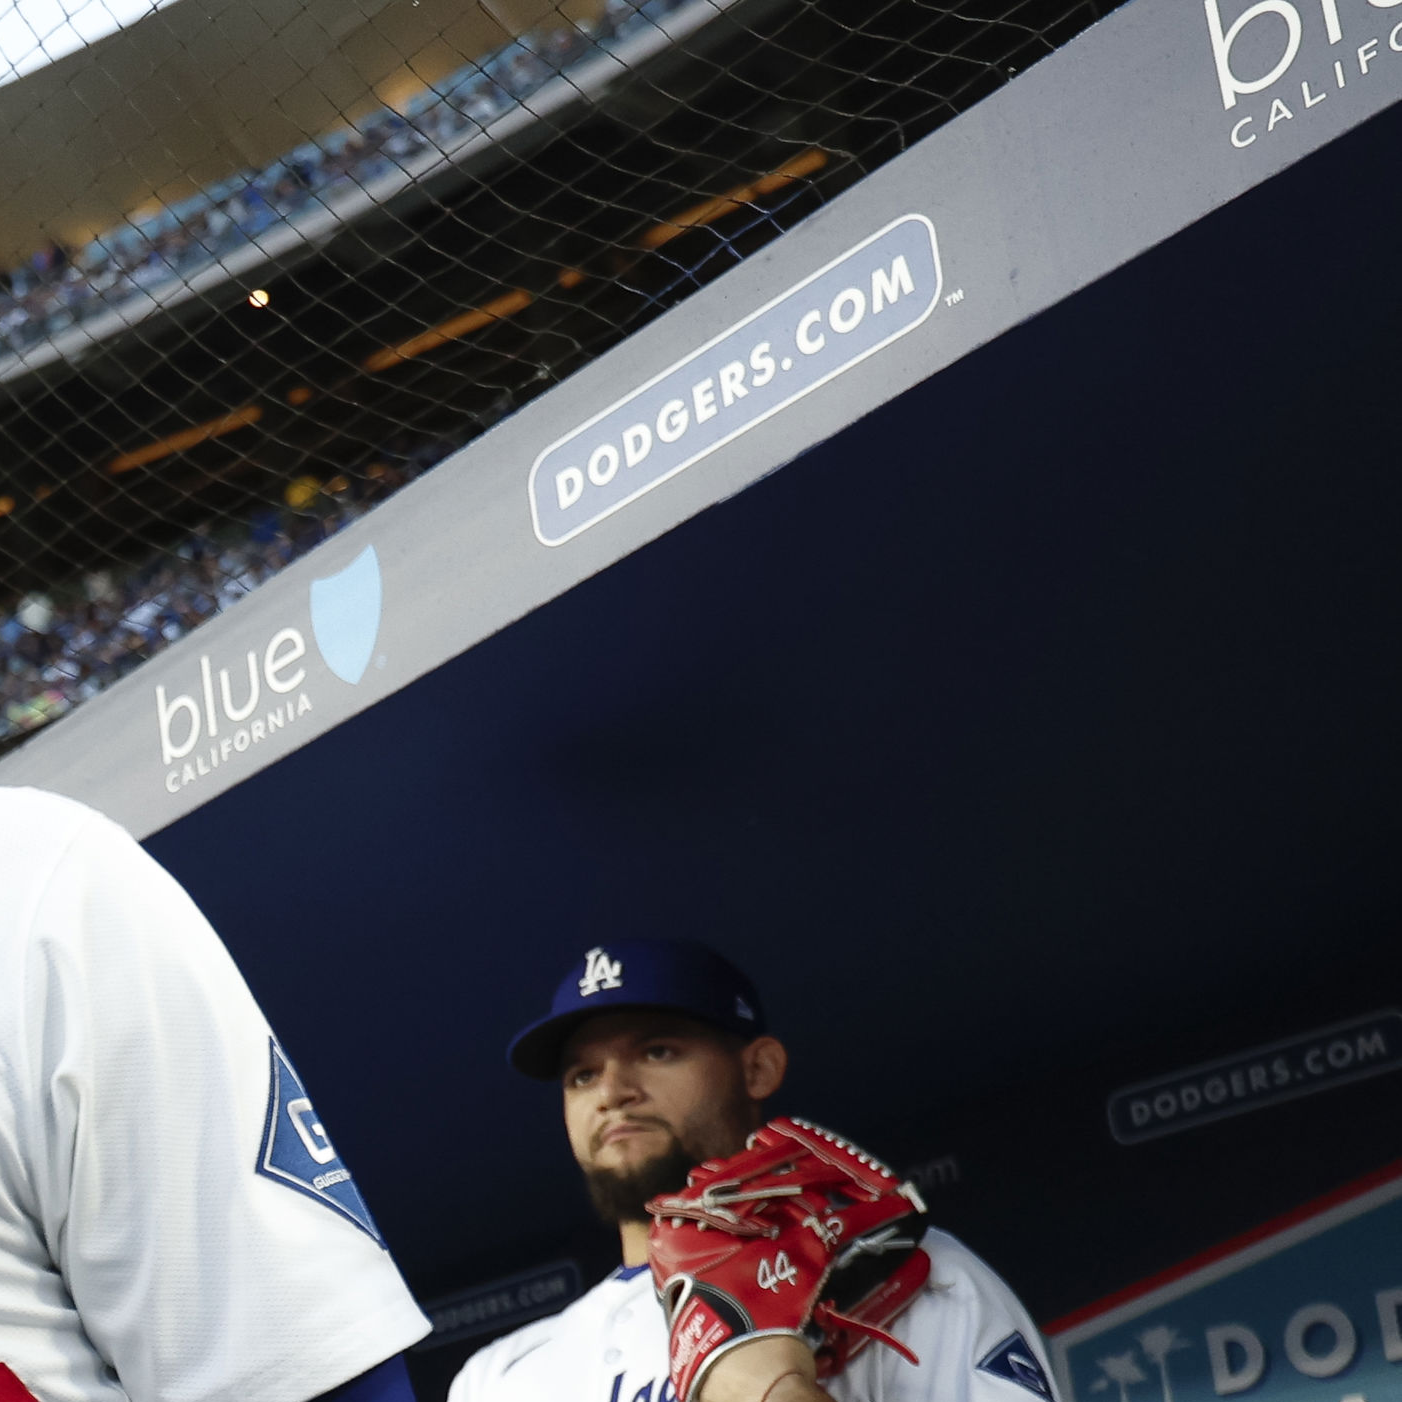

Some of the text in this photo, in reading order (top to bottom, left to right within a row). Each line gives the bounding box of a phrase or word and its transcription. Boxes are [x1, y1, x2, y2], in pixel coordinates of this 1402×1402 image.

[555, 254, 916, 510] DODGERS.COM
[156, 627, 306, 765] blue
[165, 692, 313, 794] CALIFORNIA
[579, 946, 623, 997] LA
[1130, 1030, 1387, 1128] DODGERS.COM
[757, 1249, 797, 1294] 44
